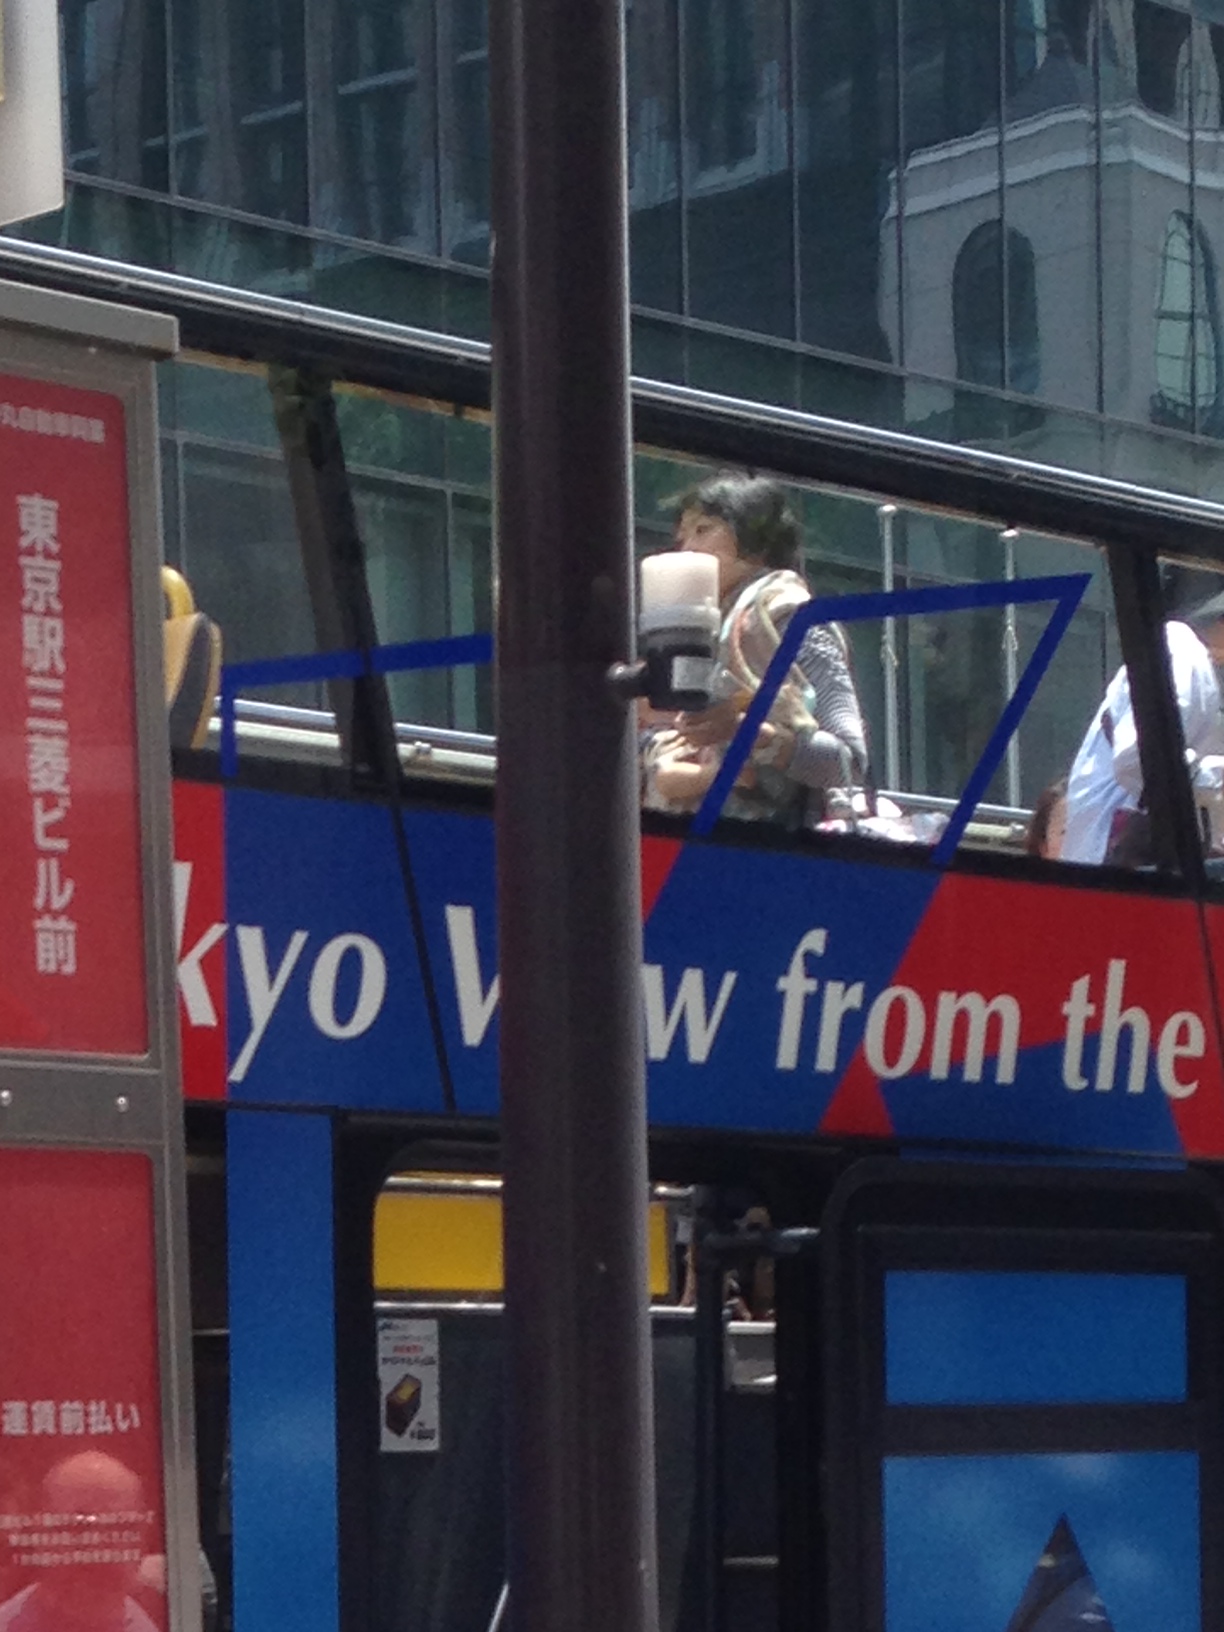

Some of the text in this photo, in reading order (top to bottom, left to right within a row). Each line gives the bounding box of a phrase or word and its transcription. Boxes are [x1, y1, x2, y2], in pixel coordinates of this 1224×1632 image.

[16, 493, 77, 977] 東京駅三菱ビル前
[776, 928, 1022, 1085] from
[1062, 958, 1207, 1100] the
[1, 1400, 141, 1436] 運賃前払い
